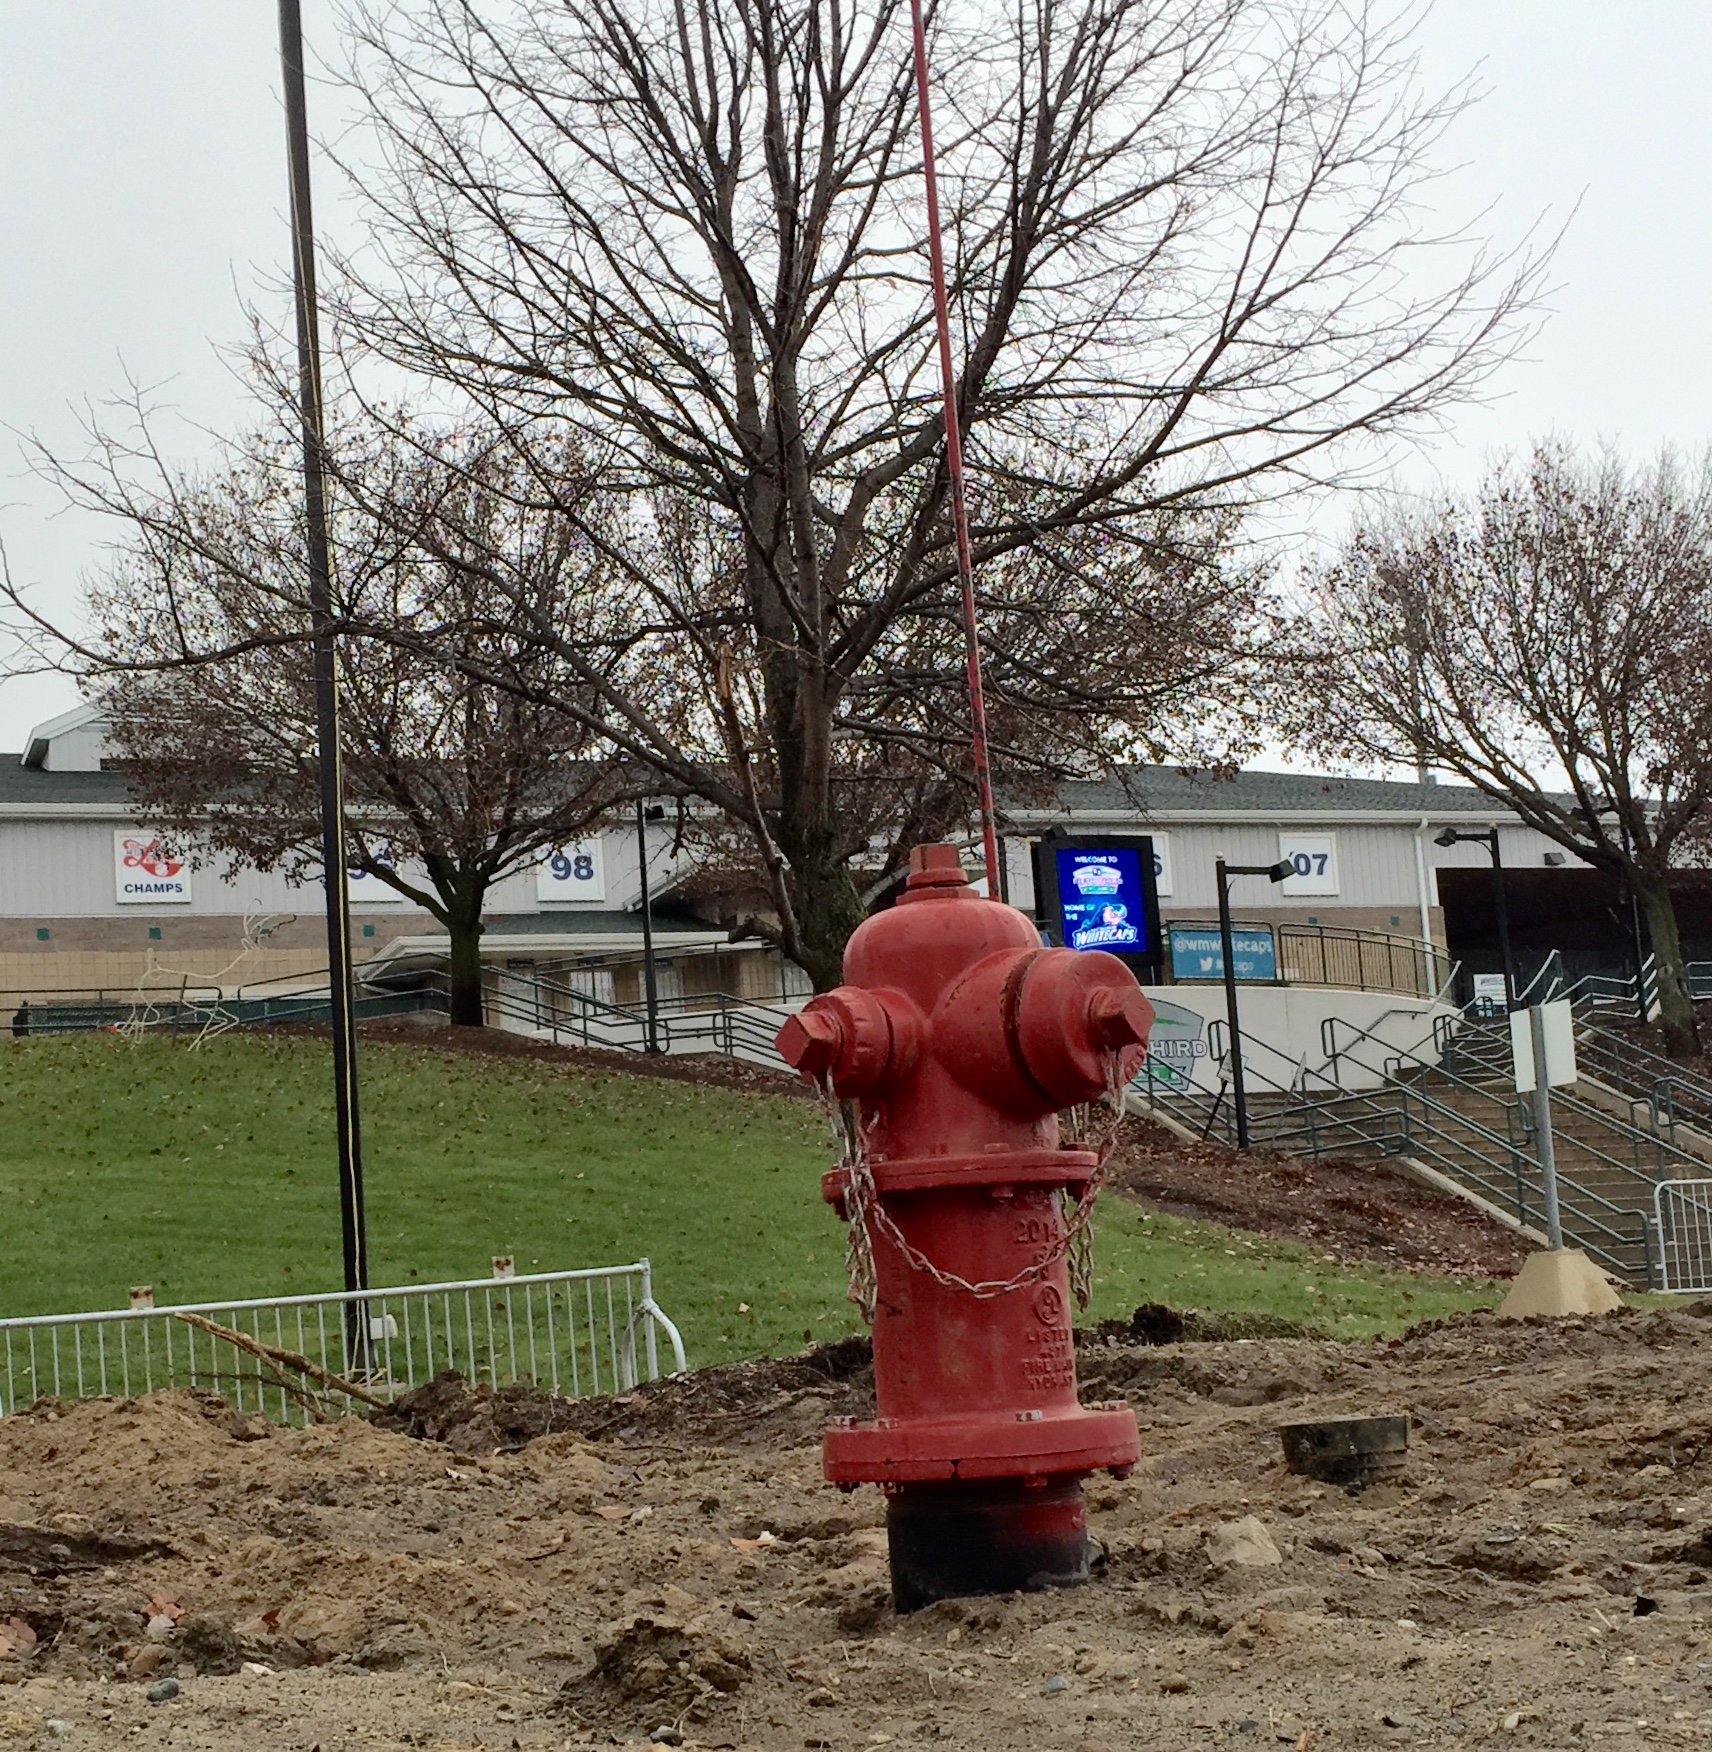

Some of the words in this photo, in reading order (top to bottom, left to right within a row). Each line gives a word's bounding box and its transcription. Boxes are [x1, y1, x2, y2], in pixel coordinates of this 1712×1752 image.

[1074, 855, 1107, 863] WELCOME
[1108, 855, 1118, 863] TO
[124, 883, 183, 893] CHAMPS
[1074, 928, 1135, 948] WHITECAPS
[1174, 938, 1273, 954] @wmwtecaps
[1149, 1039, 1208, 1058] HIRD
